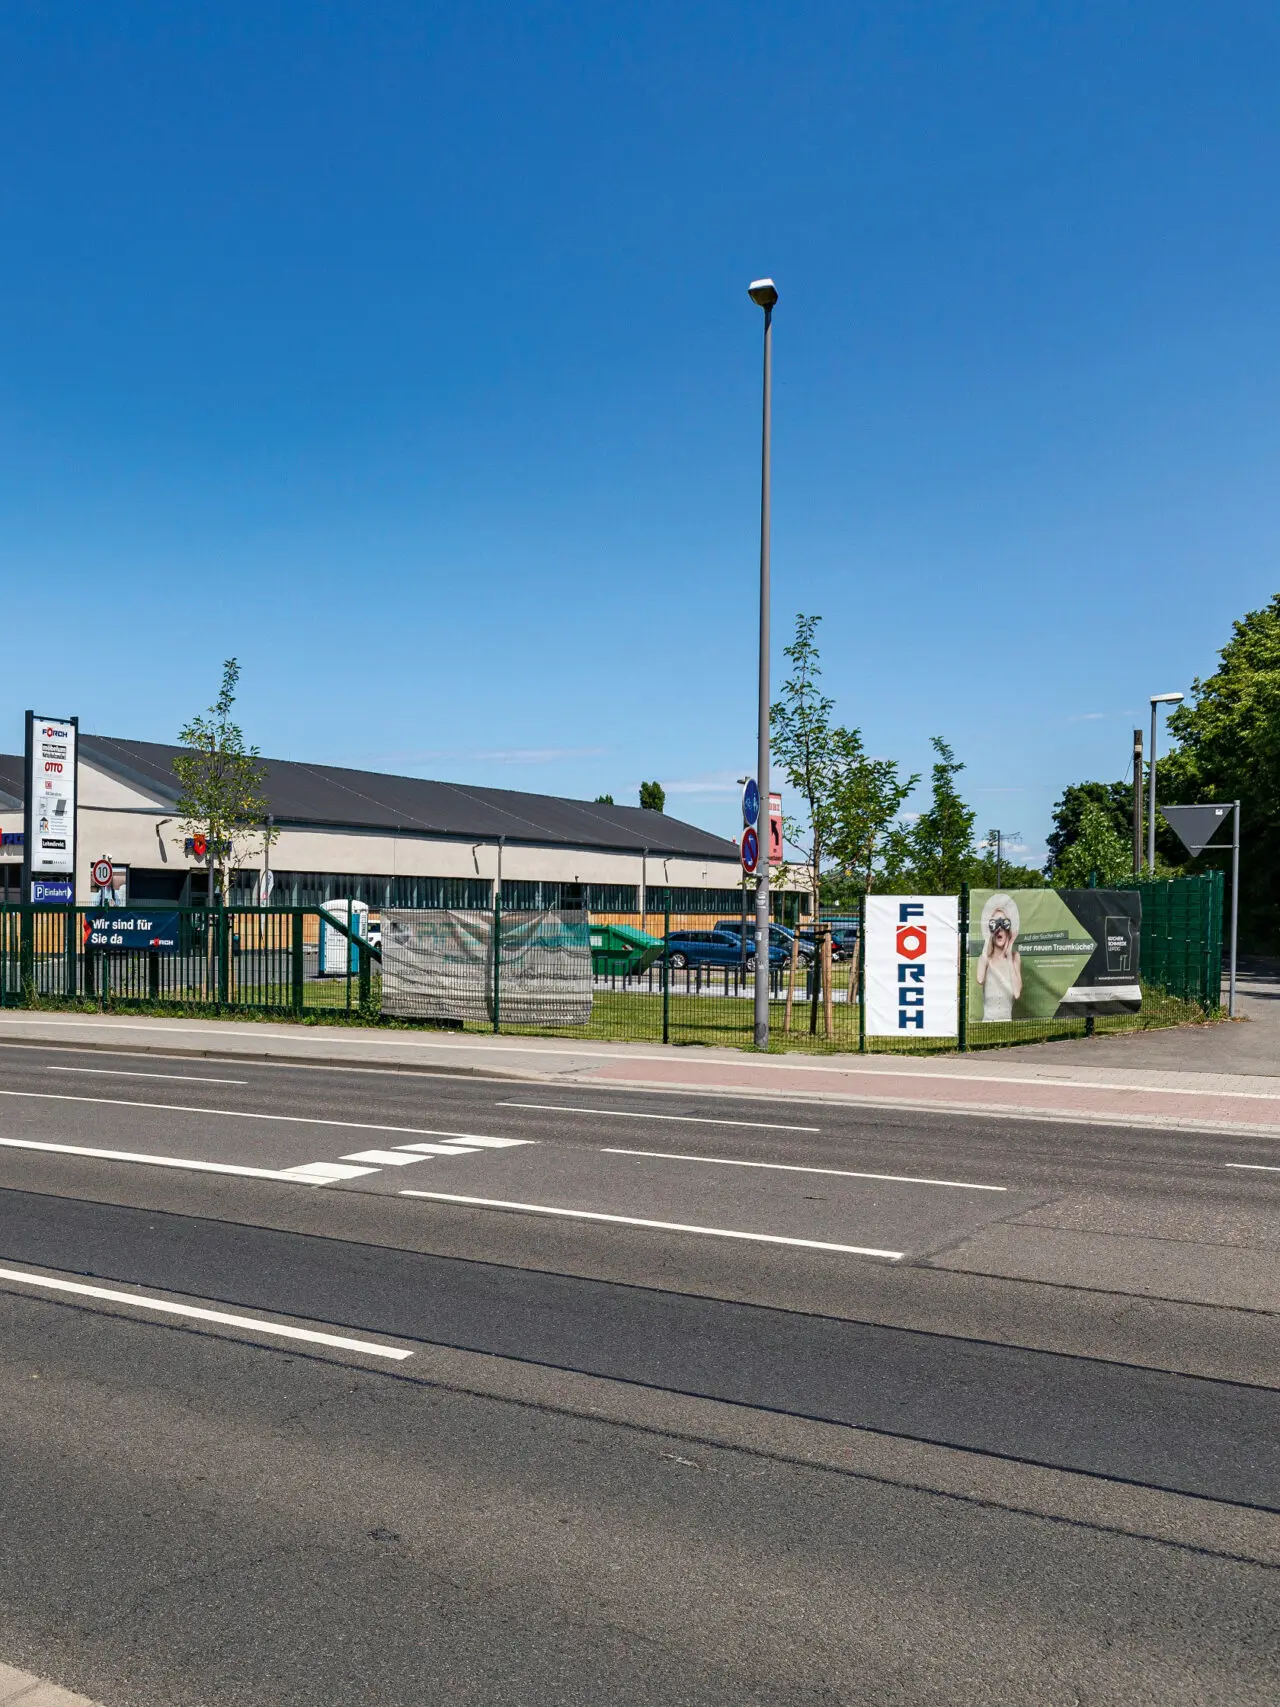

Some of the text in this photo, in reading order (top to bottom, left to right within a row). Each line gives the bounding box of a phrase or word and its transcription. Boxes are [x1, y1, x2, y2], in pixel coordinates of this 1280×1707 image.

[44, 761, 63, 773] OTTO
[98, 866, 108, 878] 10
[36, 886, 67, 899] P Einfahrt
[92, 919, 152, 931] Wir sind für
[91, 933, 123, 944] Sie da
[1018, 944, 1032, 952] Ihrer
[1053, 943, 1094, 951] Traumküche?
[896, 903, 927, 1029] FÖRCH
